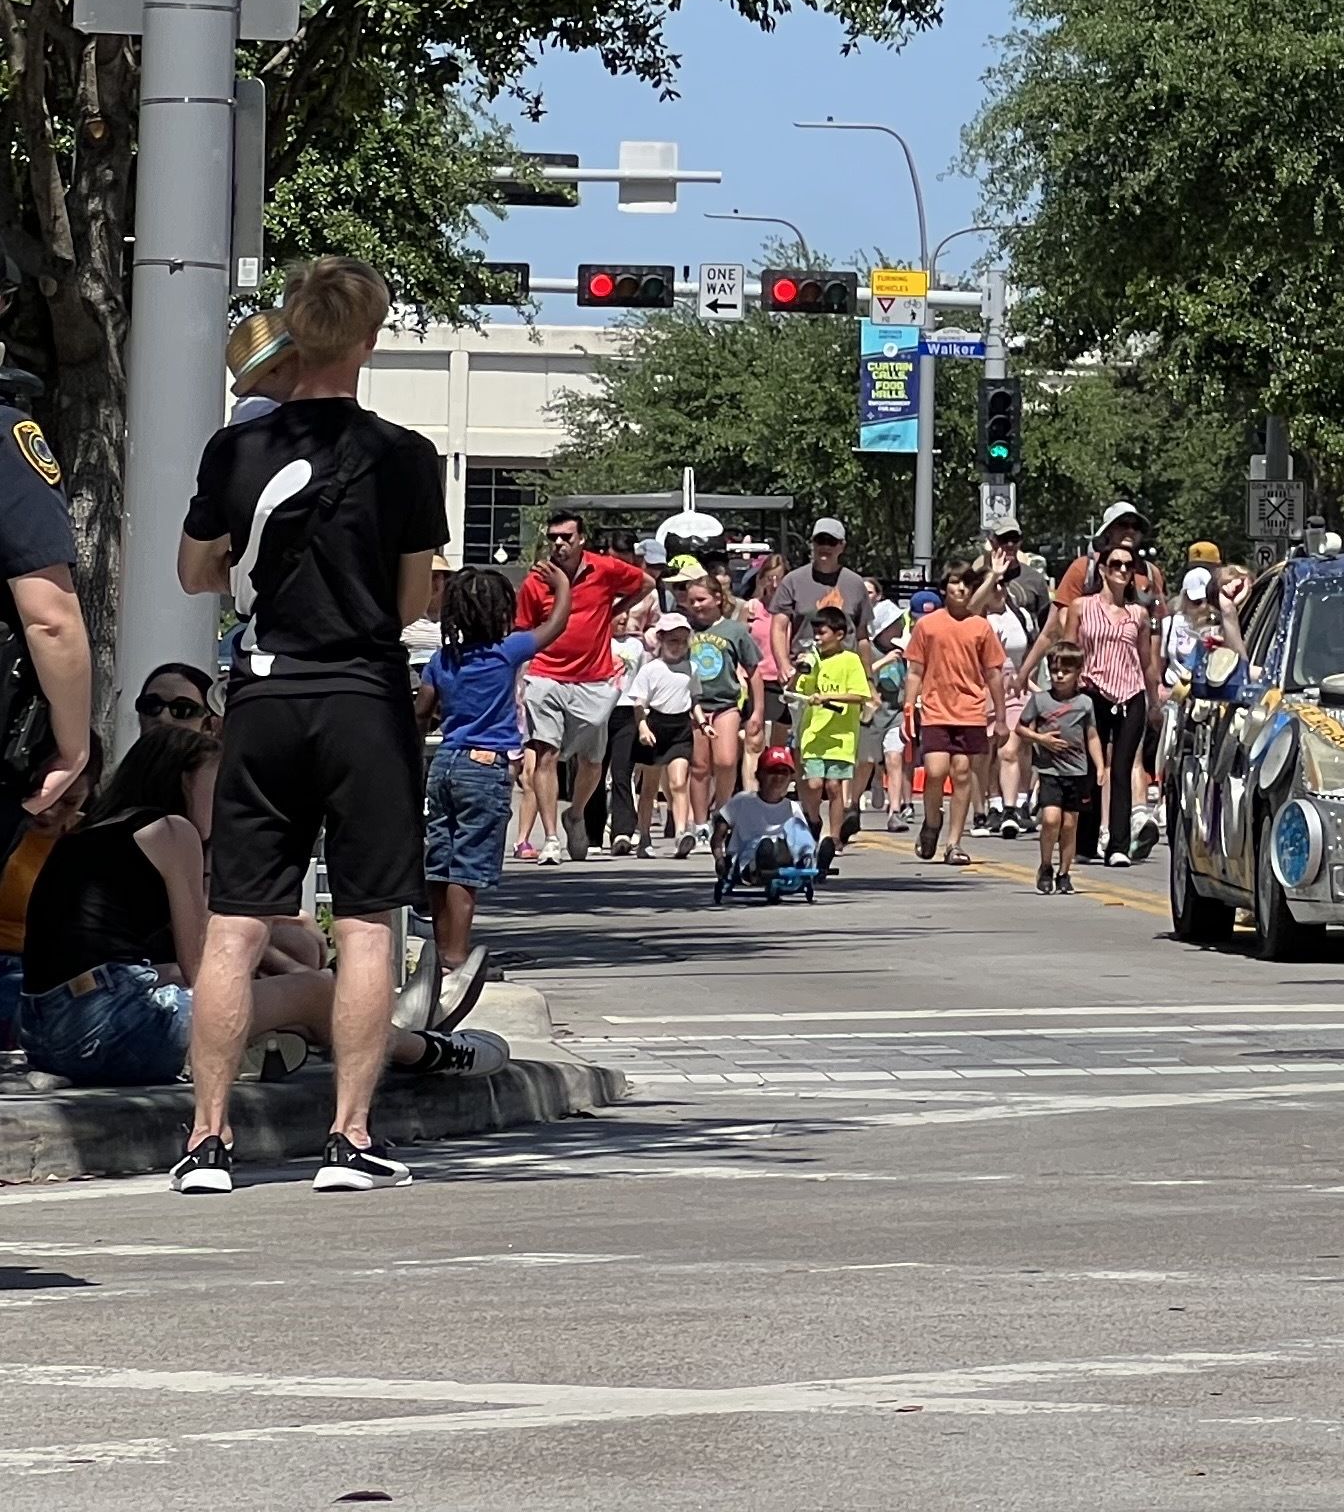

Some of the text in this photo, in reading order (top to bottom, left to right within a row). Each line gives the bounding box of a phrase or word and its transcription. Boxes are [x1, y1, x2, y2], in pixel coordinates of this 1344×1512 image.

[707, 268, 736, 281] ONE
[706, 283, 736, 295] WAY
[927, 343, 976, 355] Walker
